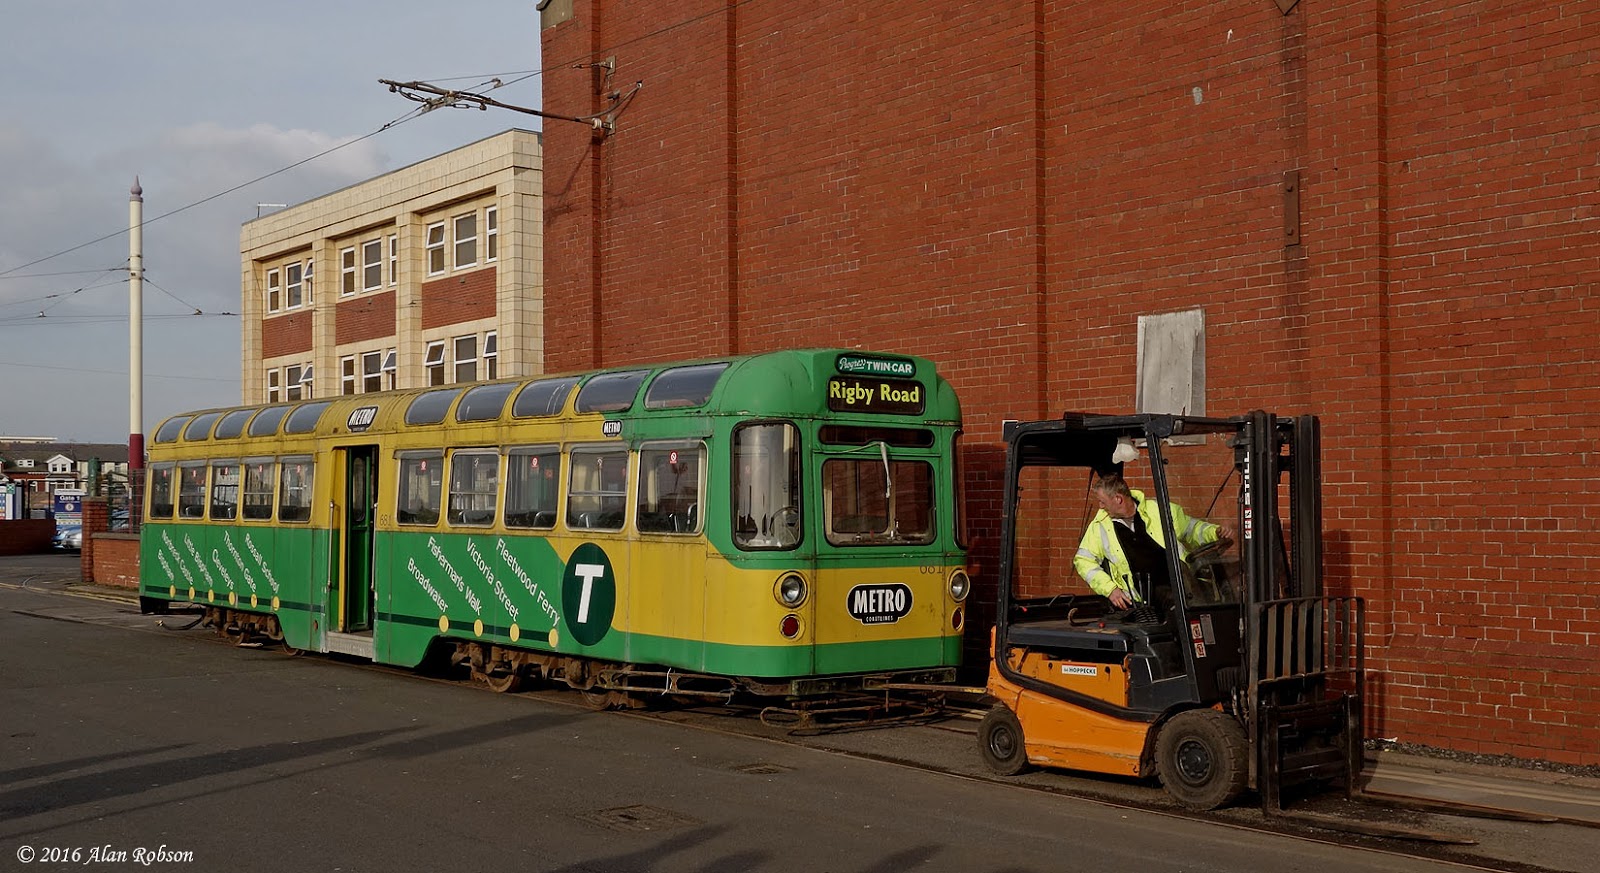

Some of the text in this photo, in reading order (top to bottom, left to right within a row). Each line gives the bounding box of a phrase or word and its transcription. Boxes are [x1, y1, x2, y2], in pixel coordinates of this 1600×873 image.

[348, 408, 376, 426] METRO
[830, 381, 919, 405] Rigby Road
[603, 422, 621, 433] METRO
[379, 513, 391, 526] 681
[212, 549, 234, 590] Cleveleys
[223, 530, 257, 593] Thornton Gate
[245, 533, 280, 594] Rossall School
[407, 557, 449, 613] Broadwater
[427, 536, 482, 616] Fisherman's Walk
[466, 537, 520, 622] Victoria Street
[495, 538, 561, 627] Fleetwood Ferry
[574, 564, 605, 624] T
[853, 588, 906, 613] METRO
[1068, 666, 1096, 675] HOPPECKE
